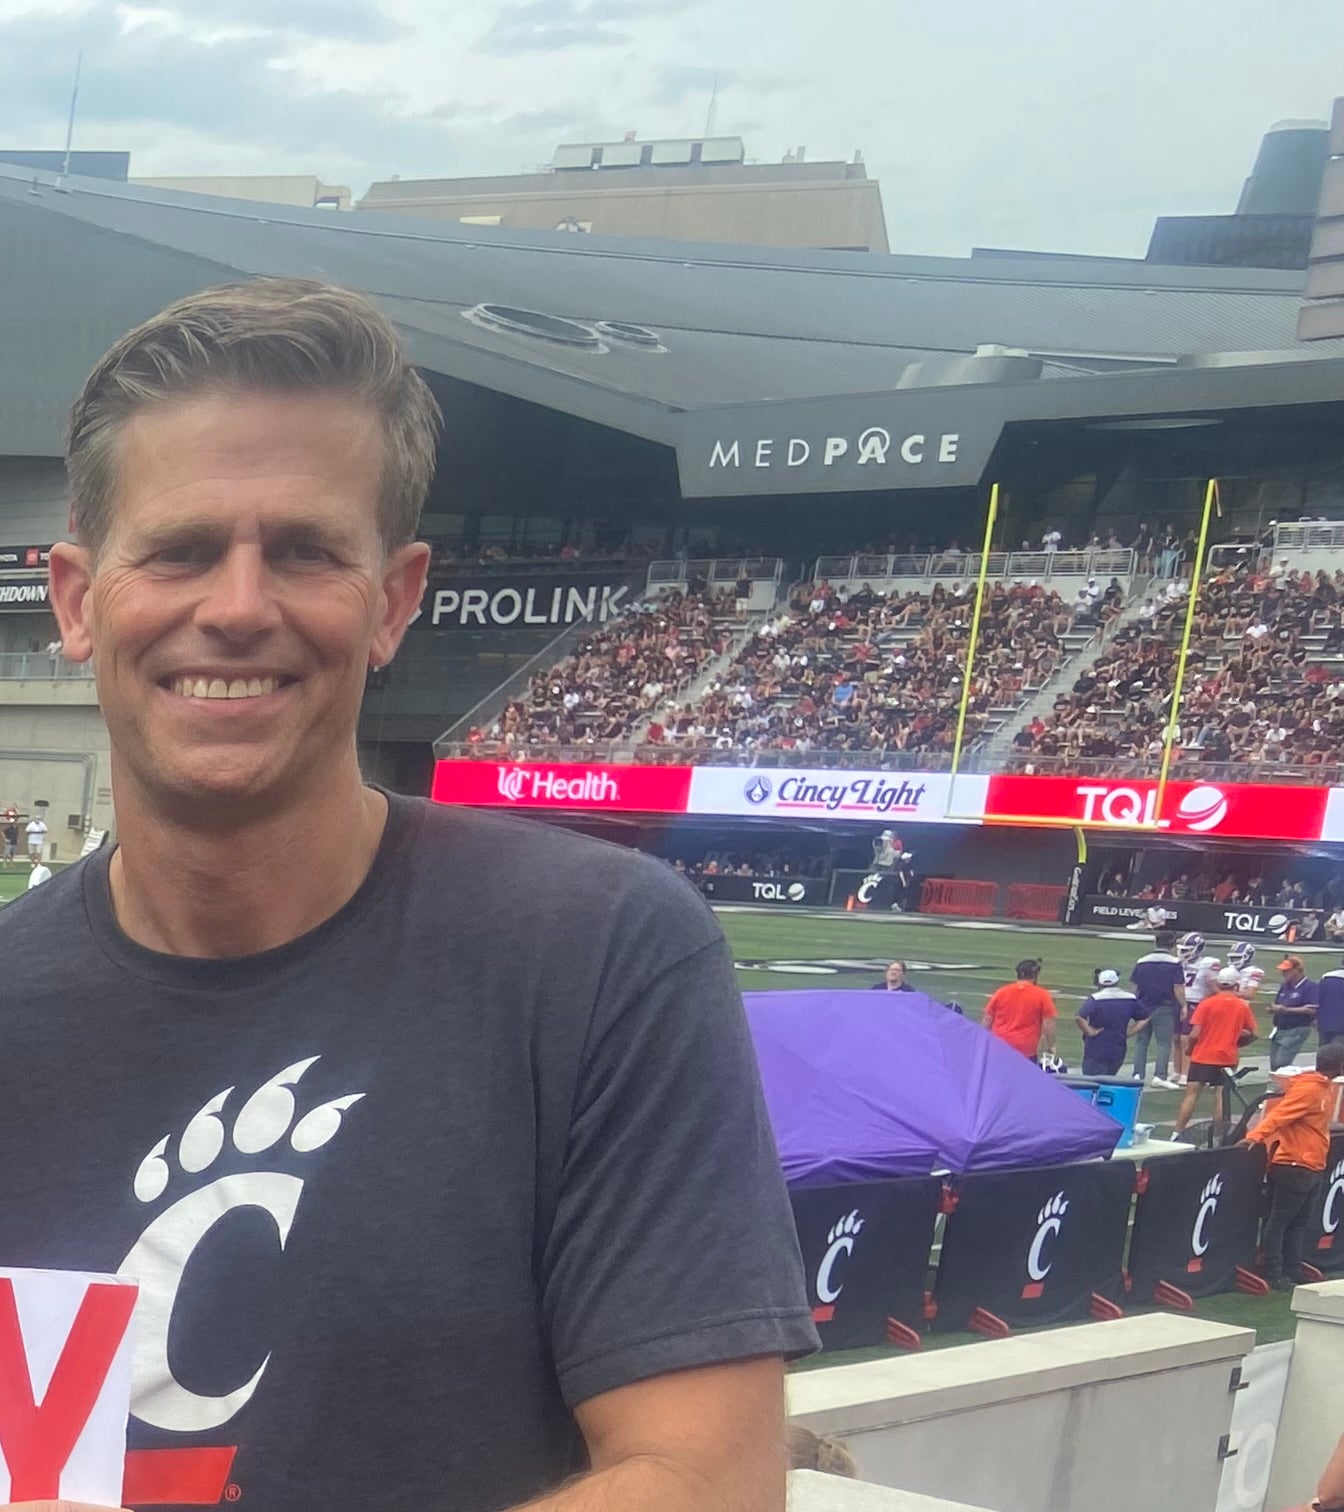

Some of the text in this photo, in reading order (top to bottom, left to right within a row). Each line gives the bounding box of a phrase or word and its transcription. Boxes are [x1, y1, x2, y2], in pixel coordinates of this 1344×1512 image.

[708, 430, 960, 468] MEDPACE
[431, 586, 629, 625] PROLINK
[532, 770, 618, 801] Health
[778, 776, 927, 813] Cincy Light
[1076, 786, 1172, 828] TQL
[752, 883, 787, 901] TQL
[1093, 905, 1148, 919] FIELD LEVE
[1223, 912, 1266, 933] TQL
